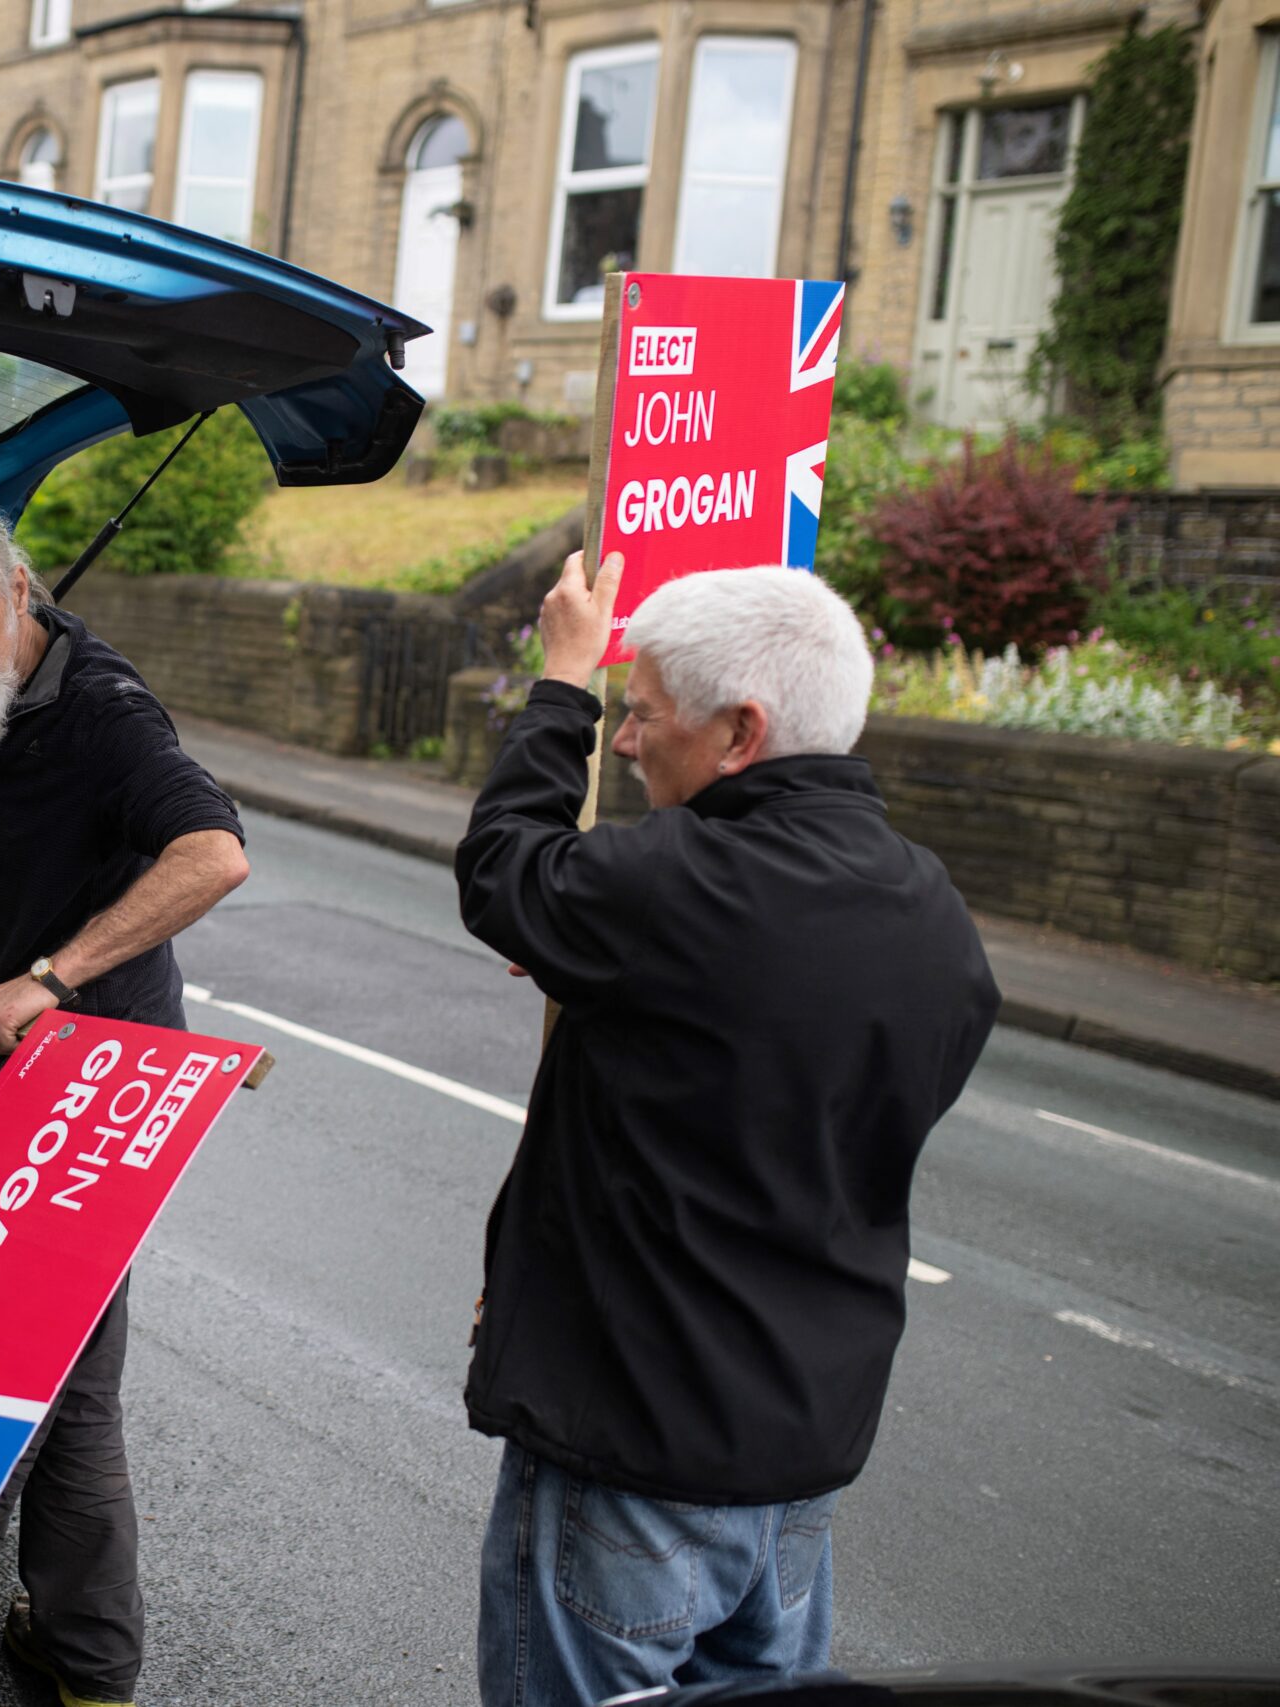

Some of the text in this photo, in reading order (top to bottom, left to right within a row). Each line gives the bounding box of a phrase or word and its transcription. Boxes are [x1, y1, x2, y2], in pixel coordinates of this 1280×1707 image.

[634, 335, 693, 366] ELECT
[624, 389, 716, 447] JOHN
[616, 468, 757, 535] GROGAN
[18, 1039, 50, 1079] Labour
[49, 1047, 168, 1211] JOHN
[131, 1064, 202, 1163] ELECT
